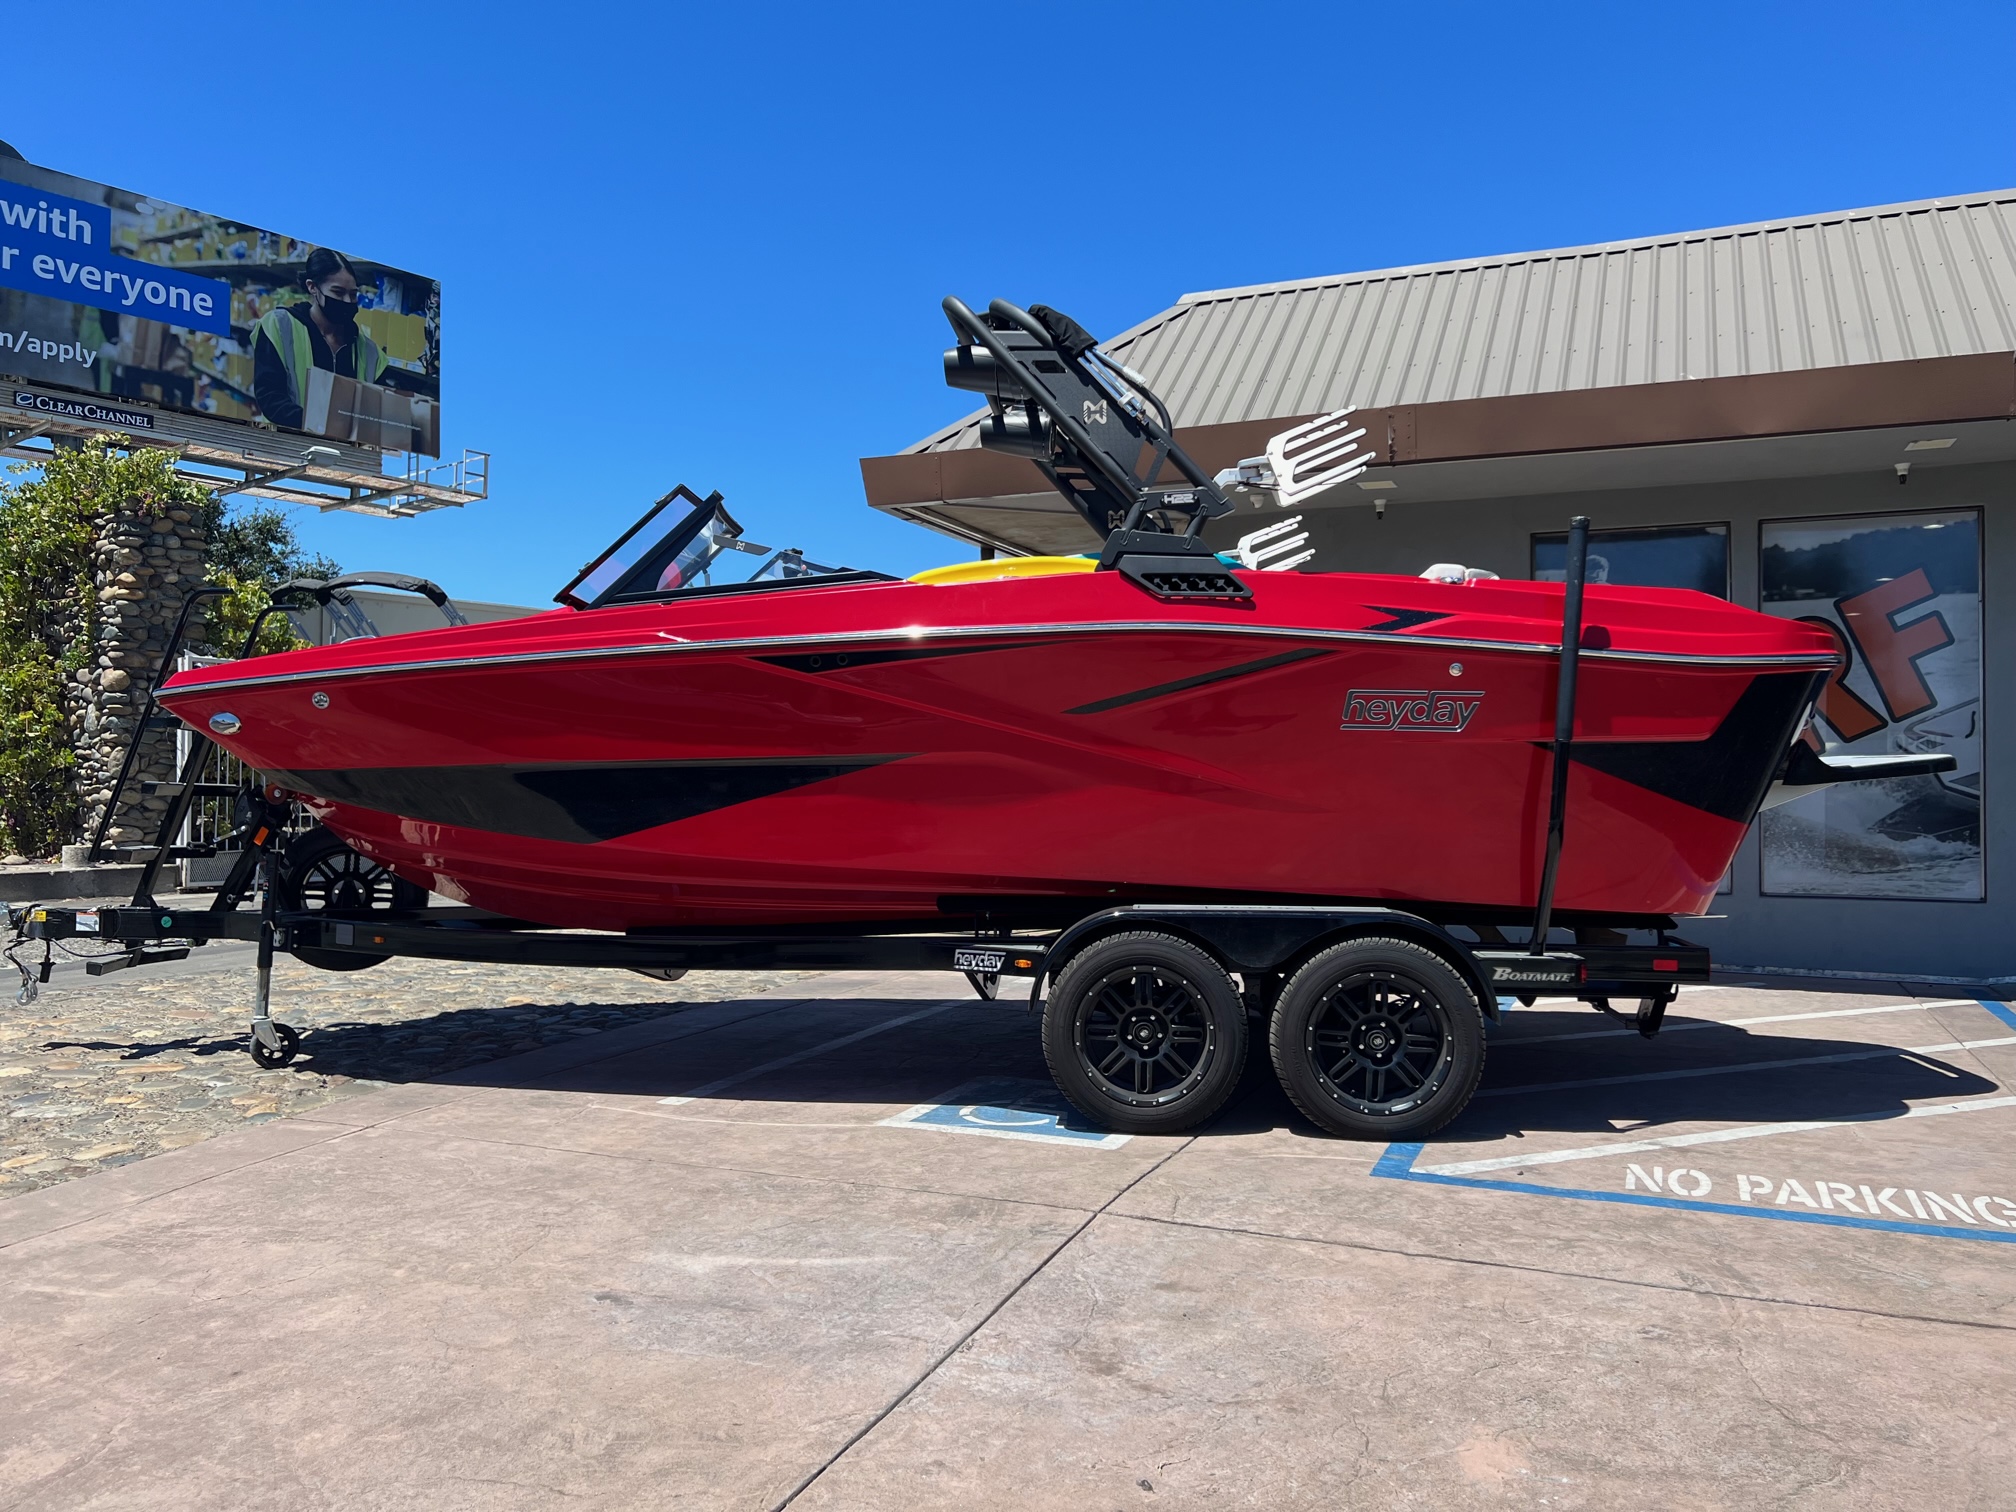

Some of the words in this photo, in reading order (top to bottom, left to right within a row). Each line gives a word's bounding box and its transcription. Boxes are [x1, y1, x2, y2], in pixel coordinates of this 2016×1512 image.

[0, 200, 92, 245] with
[32, 254, 213, 316] everyone
[1340, 689, 1486, 733] heyday
[953, 948, 1007, 972] heyday
[1625, 1163, 1712, 1197] NO
[1737, 1174, 2016, 1227] PARKING
